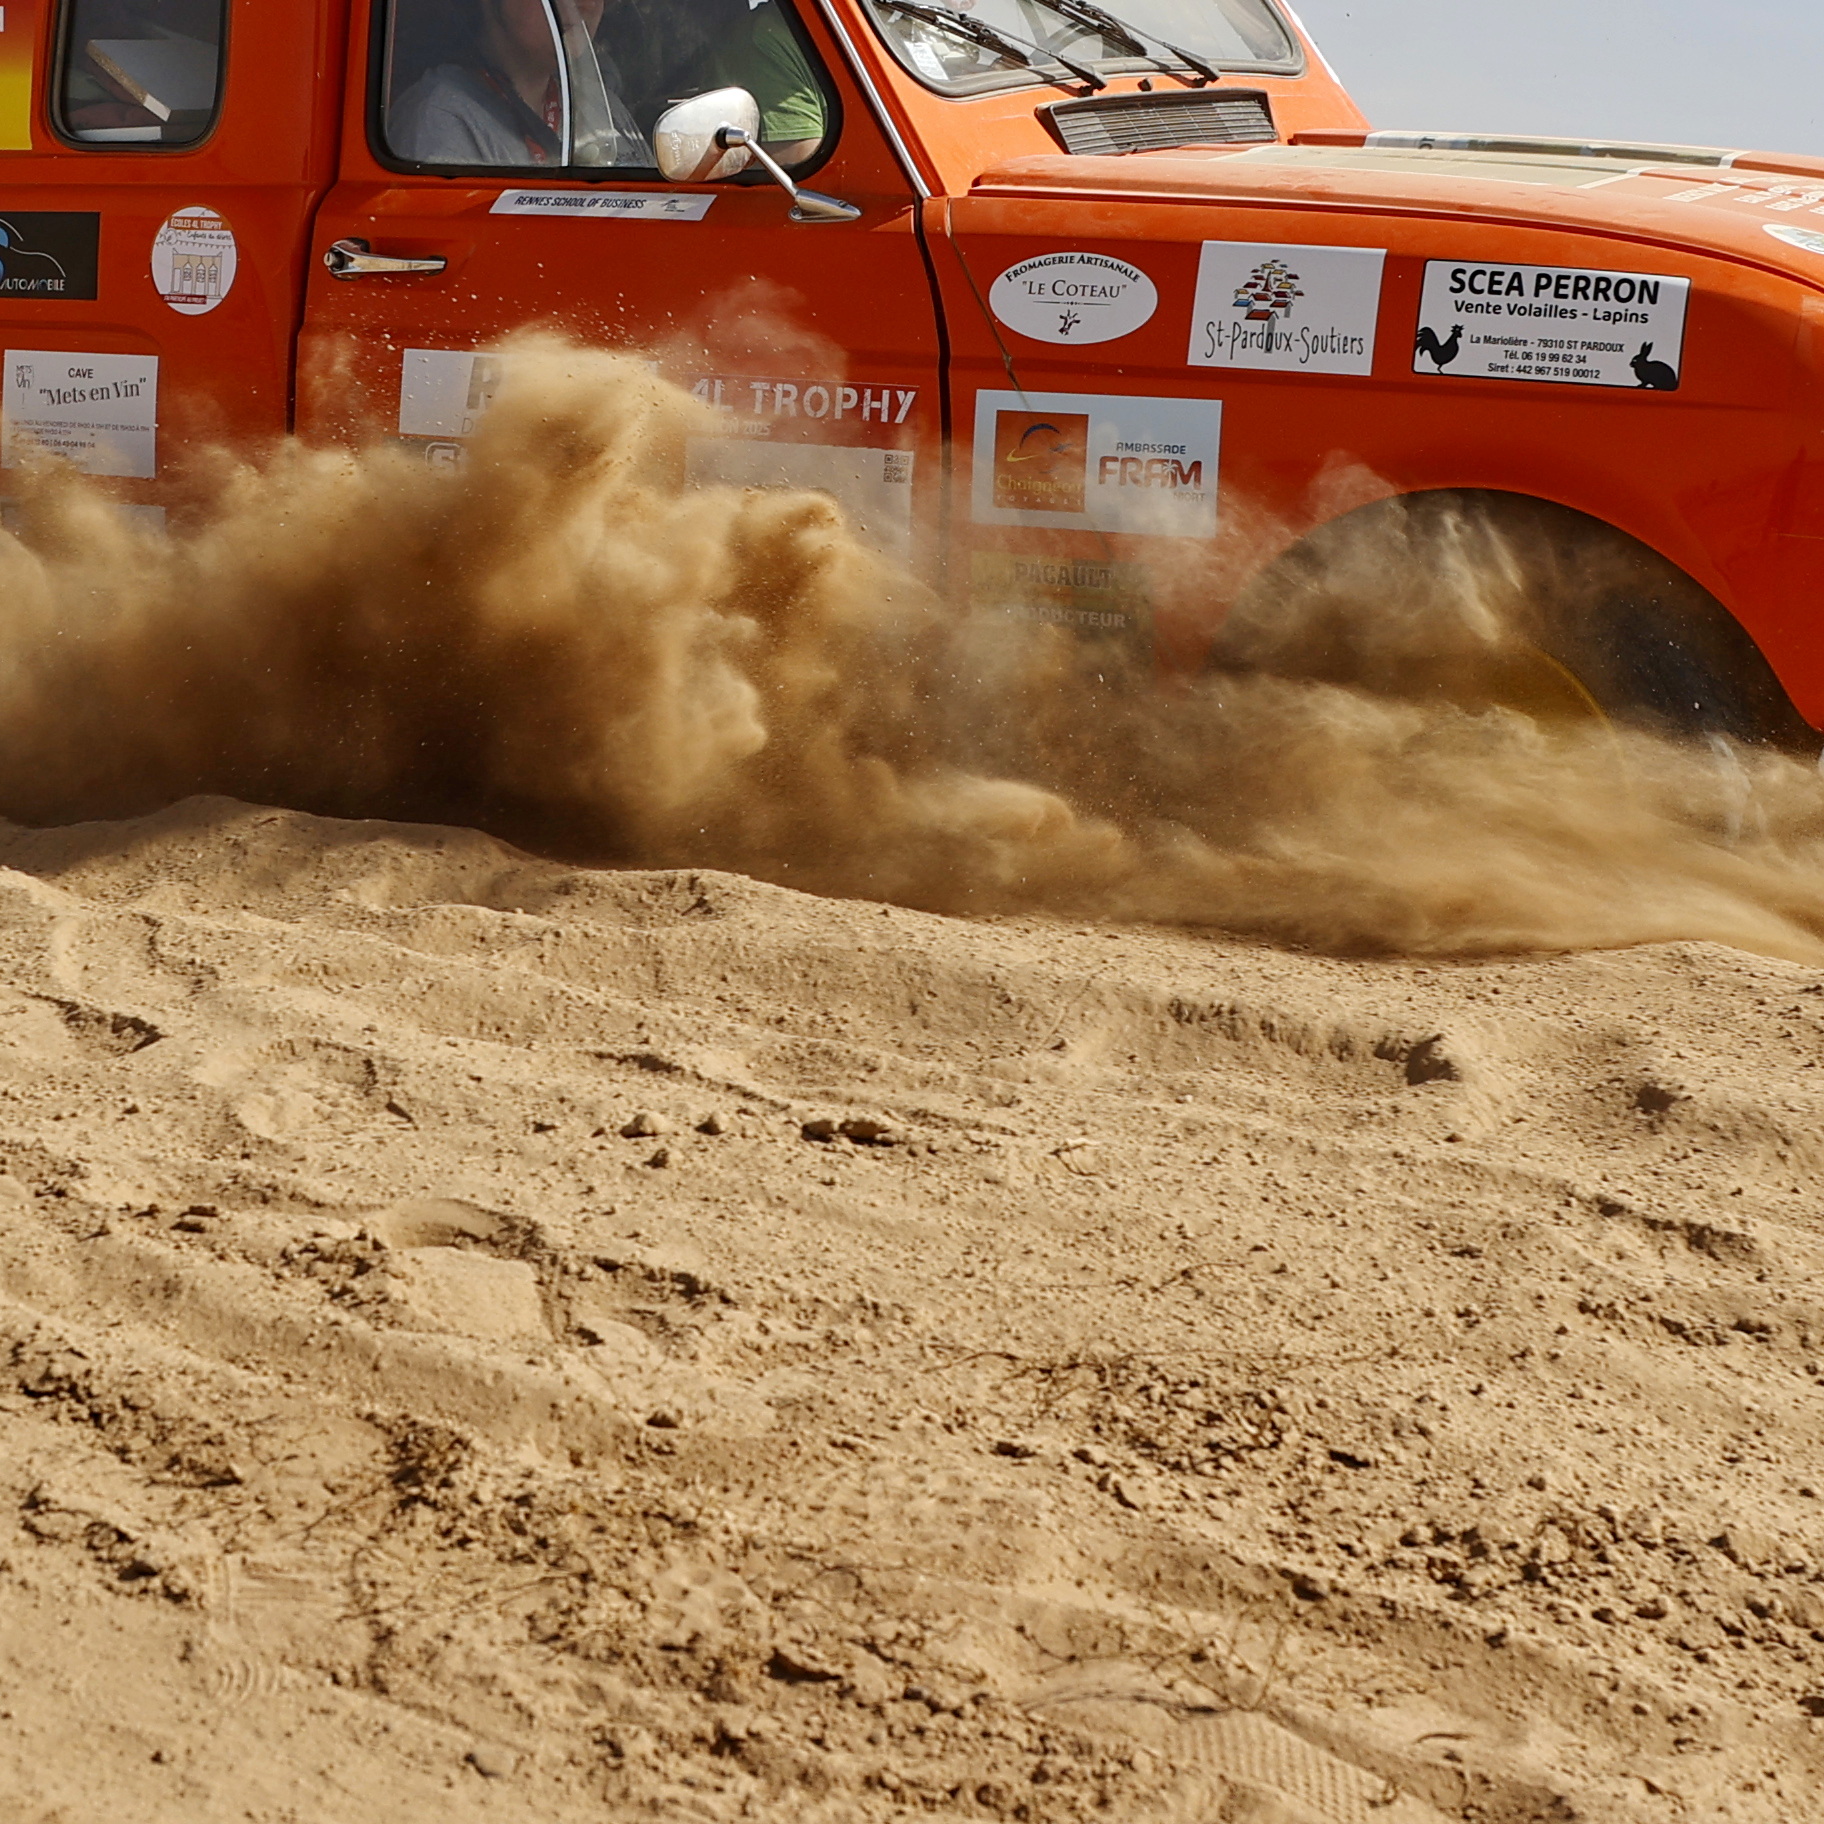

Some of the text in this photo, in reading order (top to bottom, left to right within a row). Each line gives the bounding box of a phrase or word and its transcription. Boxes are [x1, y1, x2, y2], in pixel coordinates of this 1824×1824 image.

[514, 196, 647, 209] RENNES SCHOOL OF BUSINESS
[0, 277, 65, 291] AUTOMOBILE
[1449, 267, 1660, 305] SCEA PERRON
[1454, 300, 1502, 315] Vente
[1506, 303, 1577, 319] Volailles
[1593, 308, 1649, 325] Lapins
[1204, 319, 1364, 364] St-Pardoux-Soutiers
[1470, 334, 1481, 344] La
[1537, 339, 1564, 349] 79310
[1566, 340, 1578, 350] ST
[1580, 342, 1625, 352] PARDOUX
[1521, 351, 1533, 361] 06
[1535, 352, 1546, 362] 19
[1548, 353, 1559, 363] 99
[1561, 354, 1573, 363] 62
[1575, 354, 1586, 364] 34
[67, 367, 94, 379] CAVE
[1488, 363, 1509, 373] Siret
[1516, 365, 1531, 375] 442
[1534, 366, 1551, 376] 967
[1553, 367, 1570, 377] 519
[1572, 368, 1601, 379] 00012
[89, 385, 110, 401] en
[690, 377, 917, 424] 4L TROPHY
[743, 423, 770, 436] 2025
[1116, 441, 1187, 455] AMBASSADE
[1098, 455, 1202, 490] FRAM
